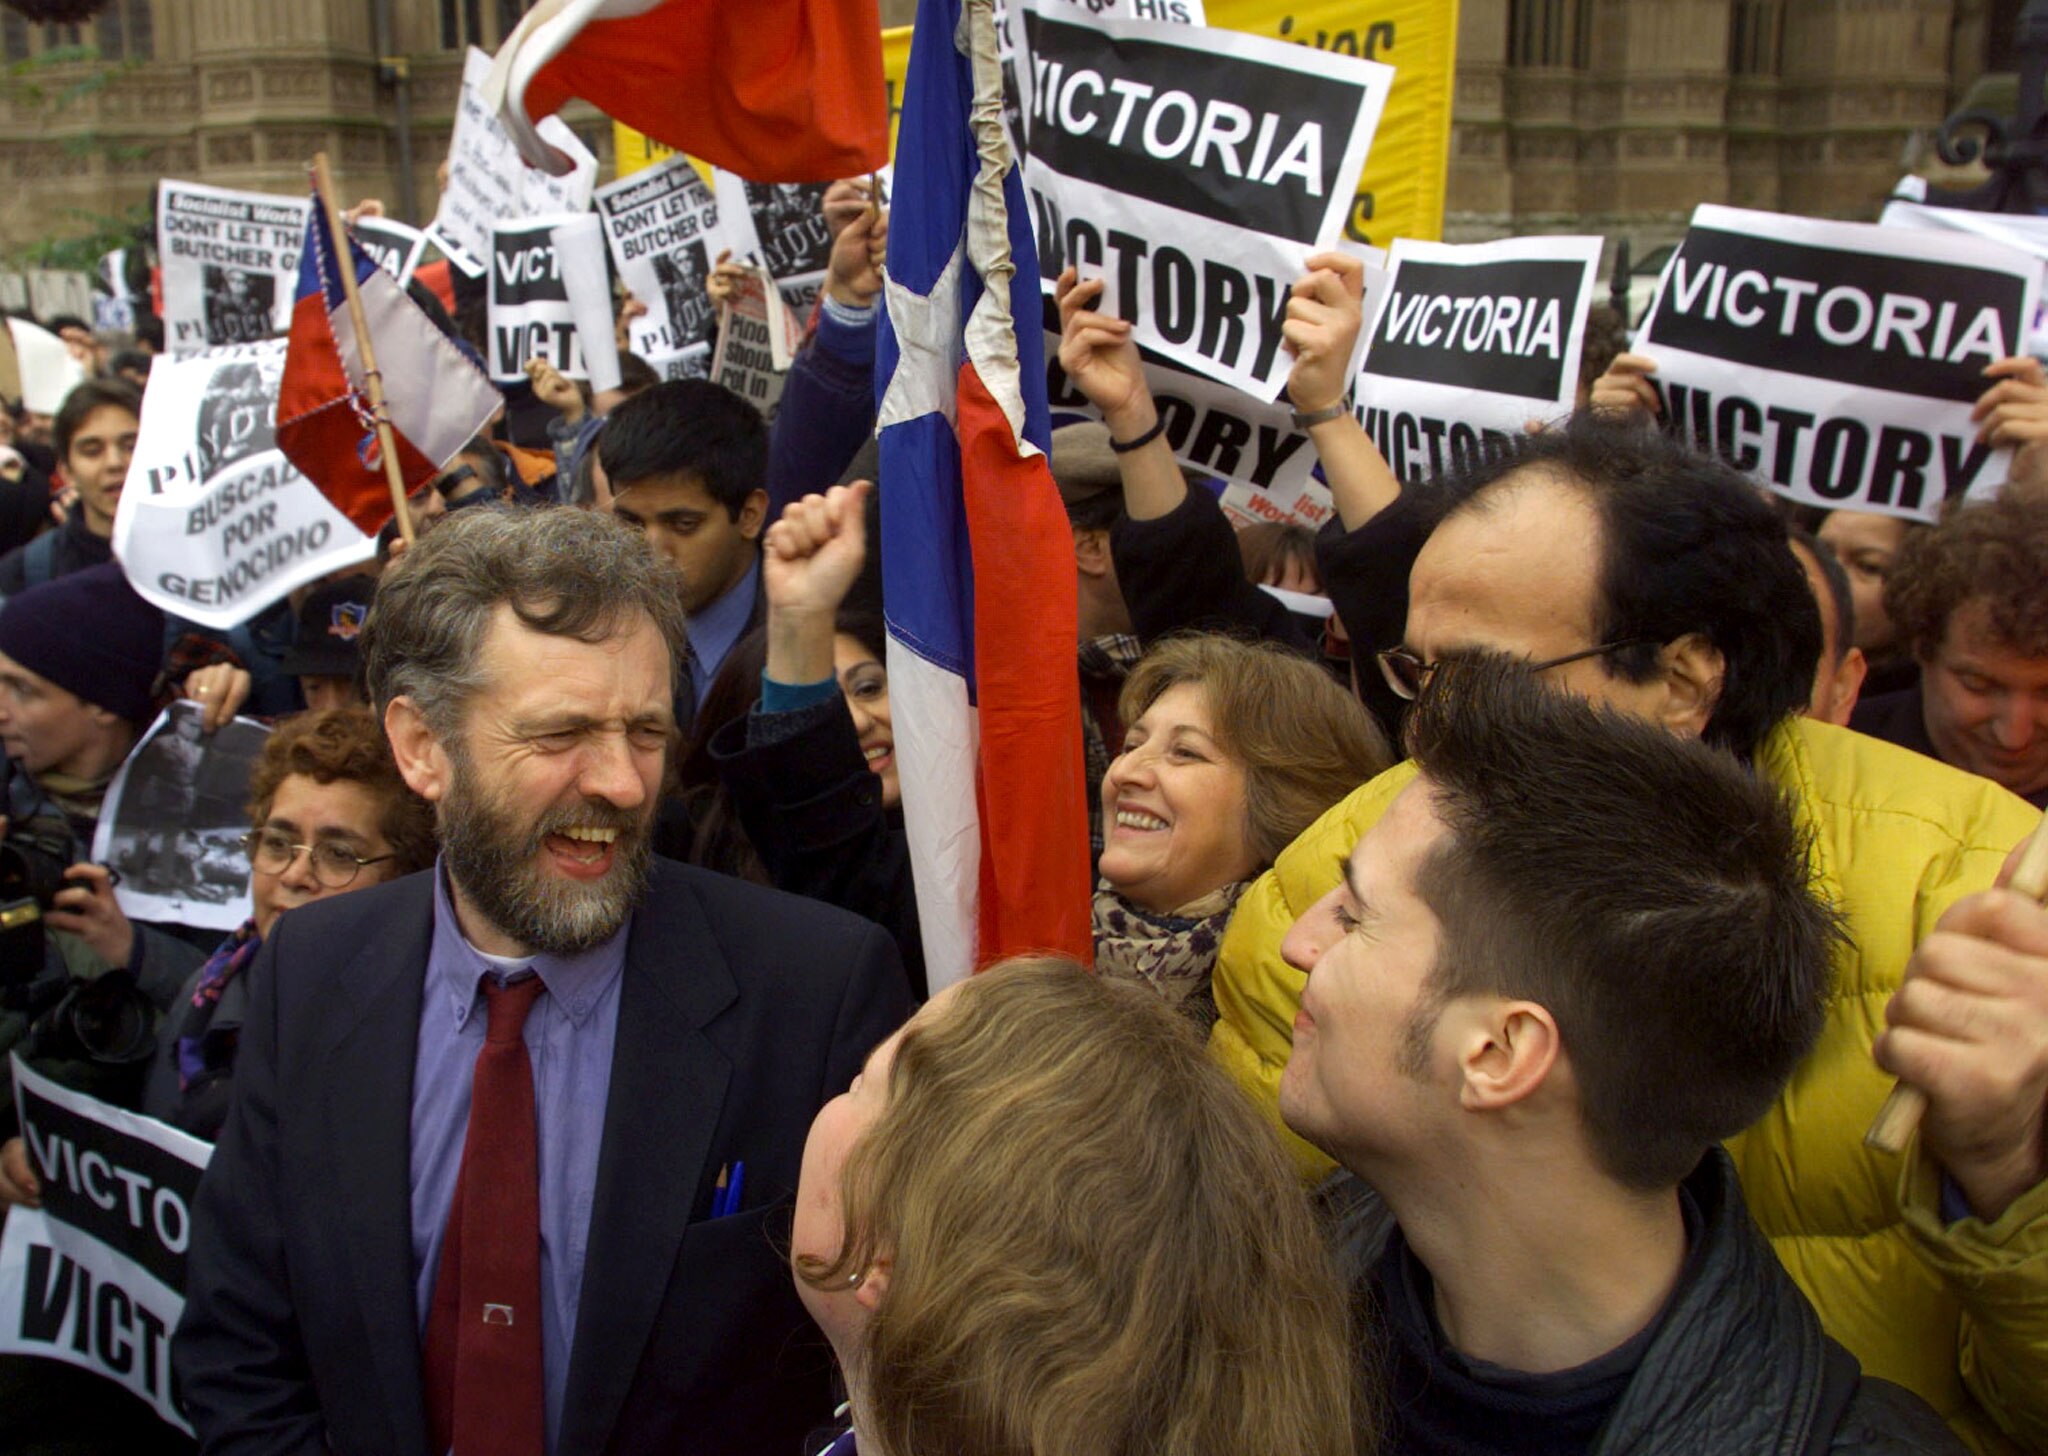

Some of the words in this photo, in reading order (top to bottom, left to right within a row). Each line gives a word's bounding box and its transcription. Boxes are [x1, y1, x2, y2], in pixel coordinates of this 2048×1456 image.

[1032, 50, 1323, 197] VICTORIA
[166, 215, 219, 238] DONT
[226, 224, 262, 244] LET
[612, 203, 656, 239] DONT
[661, 192, 687, 220] LET
[622, 214, 699, 261] BUTCHER
[172, 238, 272, 268] BUTCHER
[1031, 188, 1292, 383] VICTORY
[1385, 292, 1561, 359] VICTORIA
[1673, 258, 2006, 364] VICTORIA
[497, 320, 588, 374] VICT
[725, 341, 785, 377] shoul
[1646, 376, 1992, 512] VICTORY
[157, 519, 331, 604] GENOCIDIO
[224, 501, 277, 556] POR
[26, 1120, 190, 1254] VICTO
[19, 1243, 166, 1399] VICT
